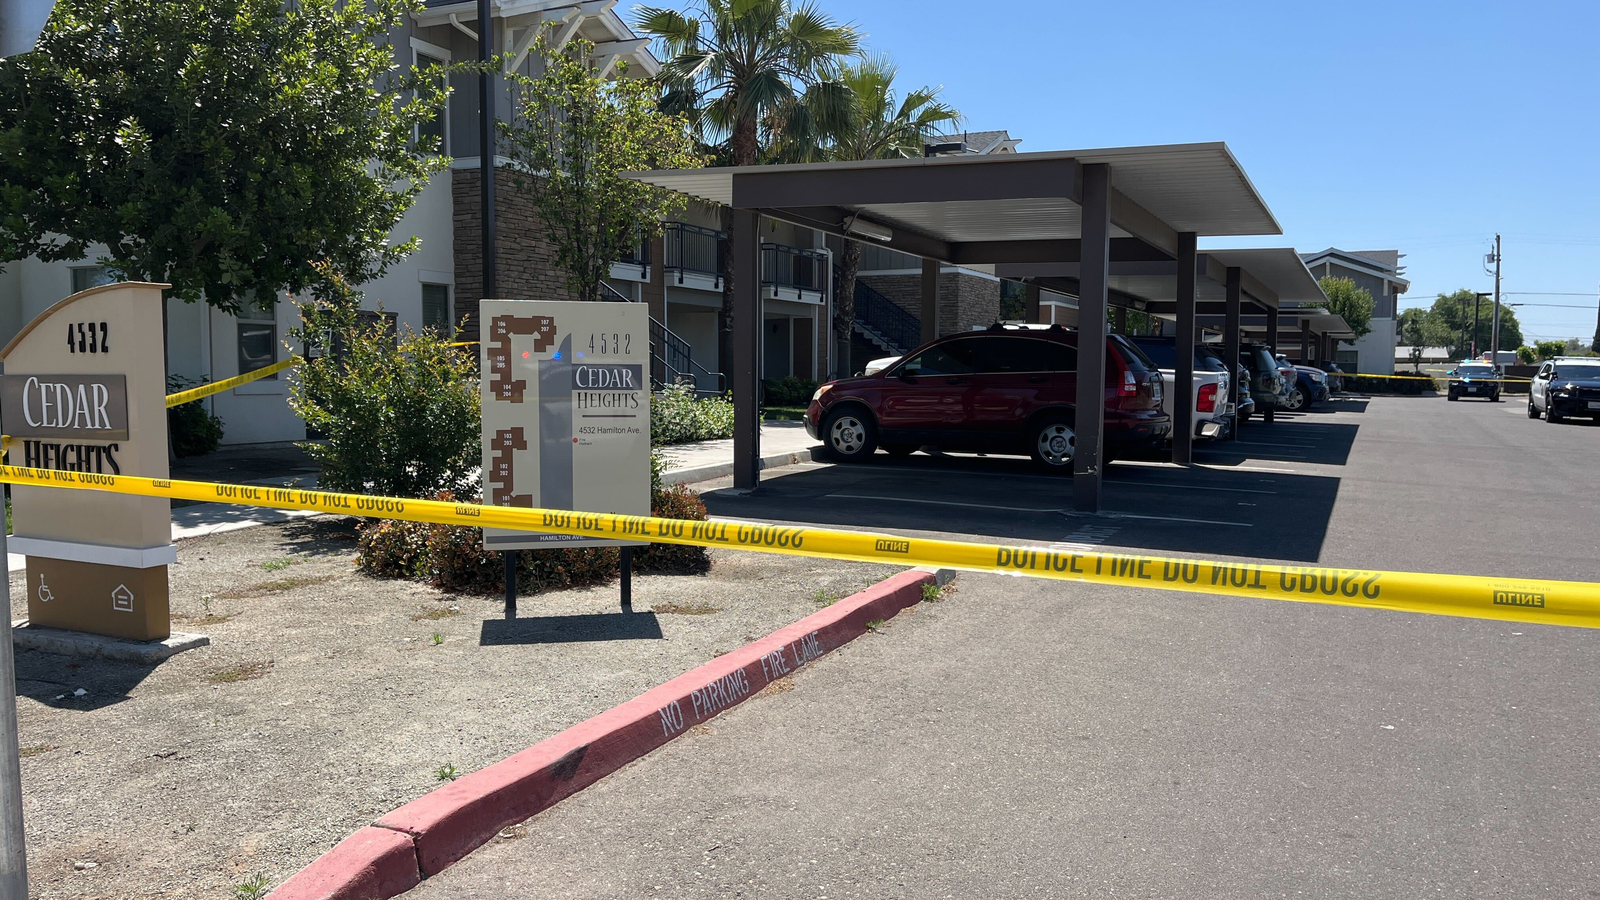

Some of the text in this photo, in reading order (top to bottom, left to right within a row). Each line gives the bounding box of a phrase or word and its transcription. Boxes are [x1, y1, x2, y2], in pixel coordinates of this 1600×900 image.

[68, 322, 109, 353] 4532
[575, 365, 633, 388] CEDAR
[22, 376, 112, 430] CEDAR
[577, 391, 639, 409] HEIGHTS
[579, 426, 642, 435] 4532 Hamilton Ave.
[658, 631, 824, 737] NO PARKING FIRE LANE
